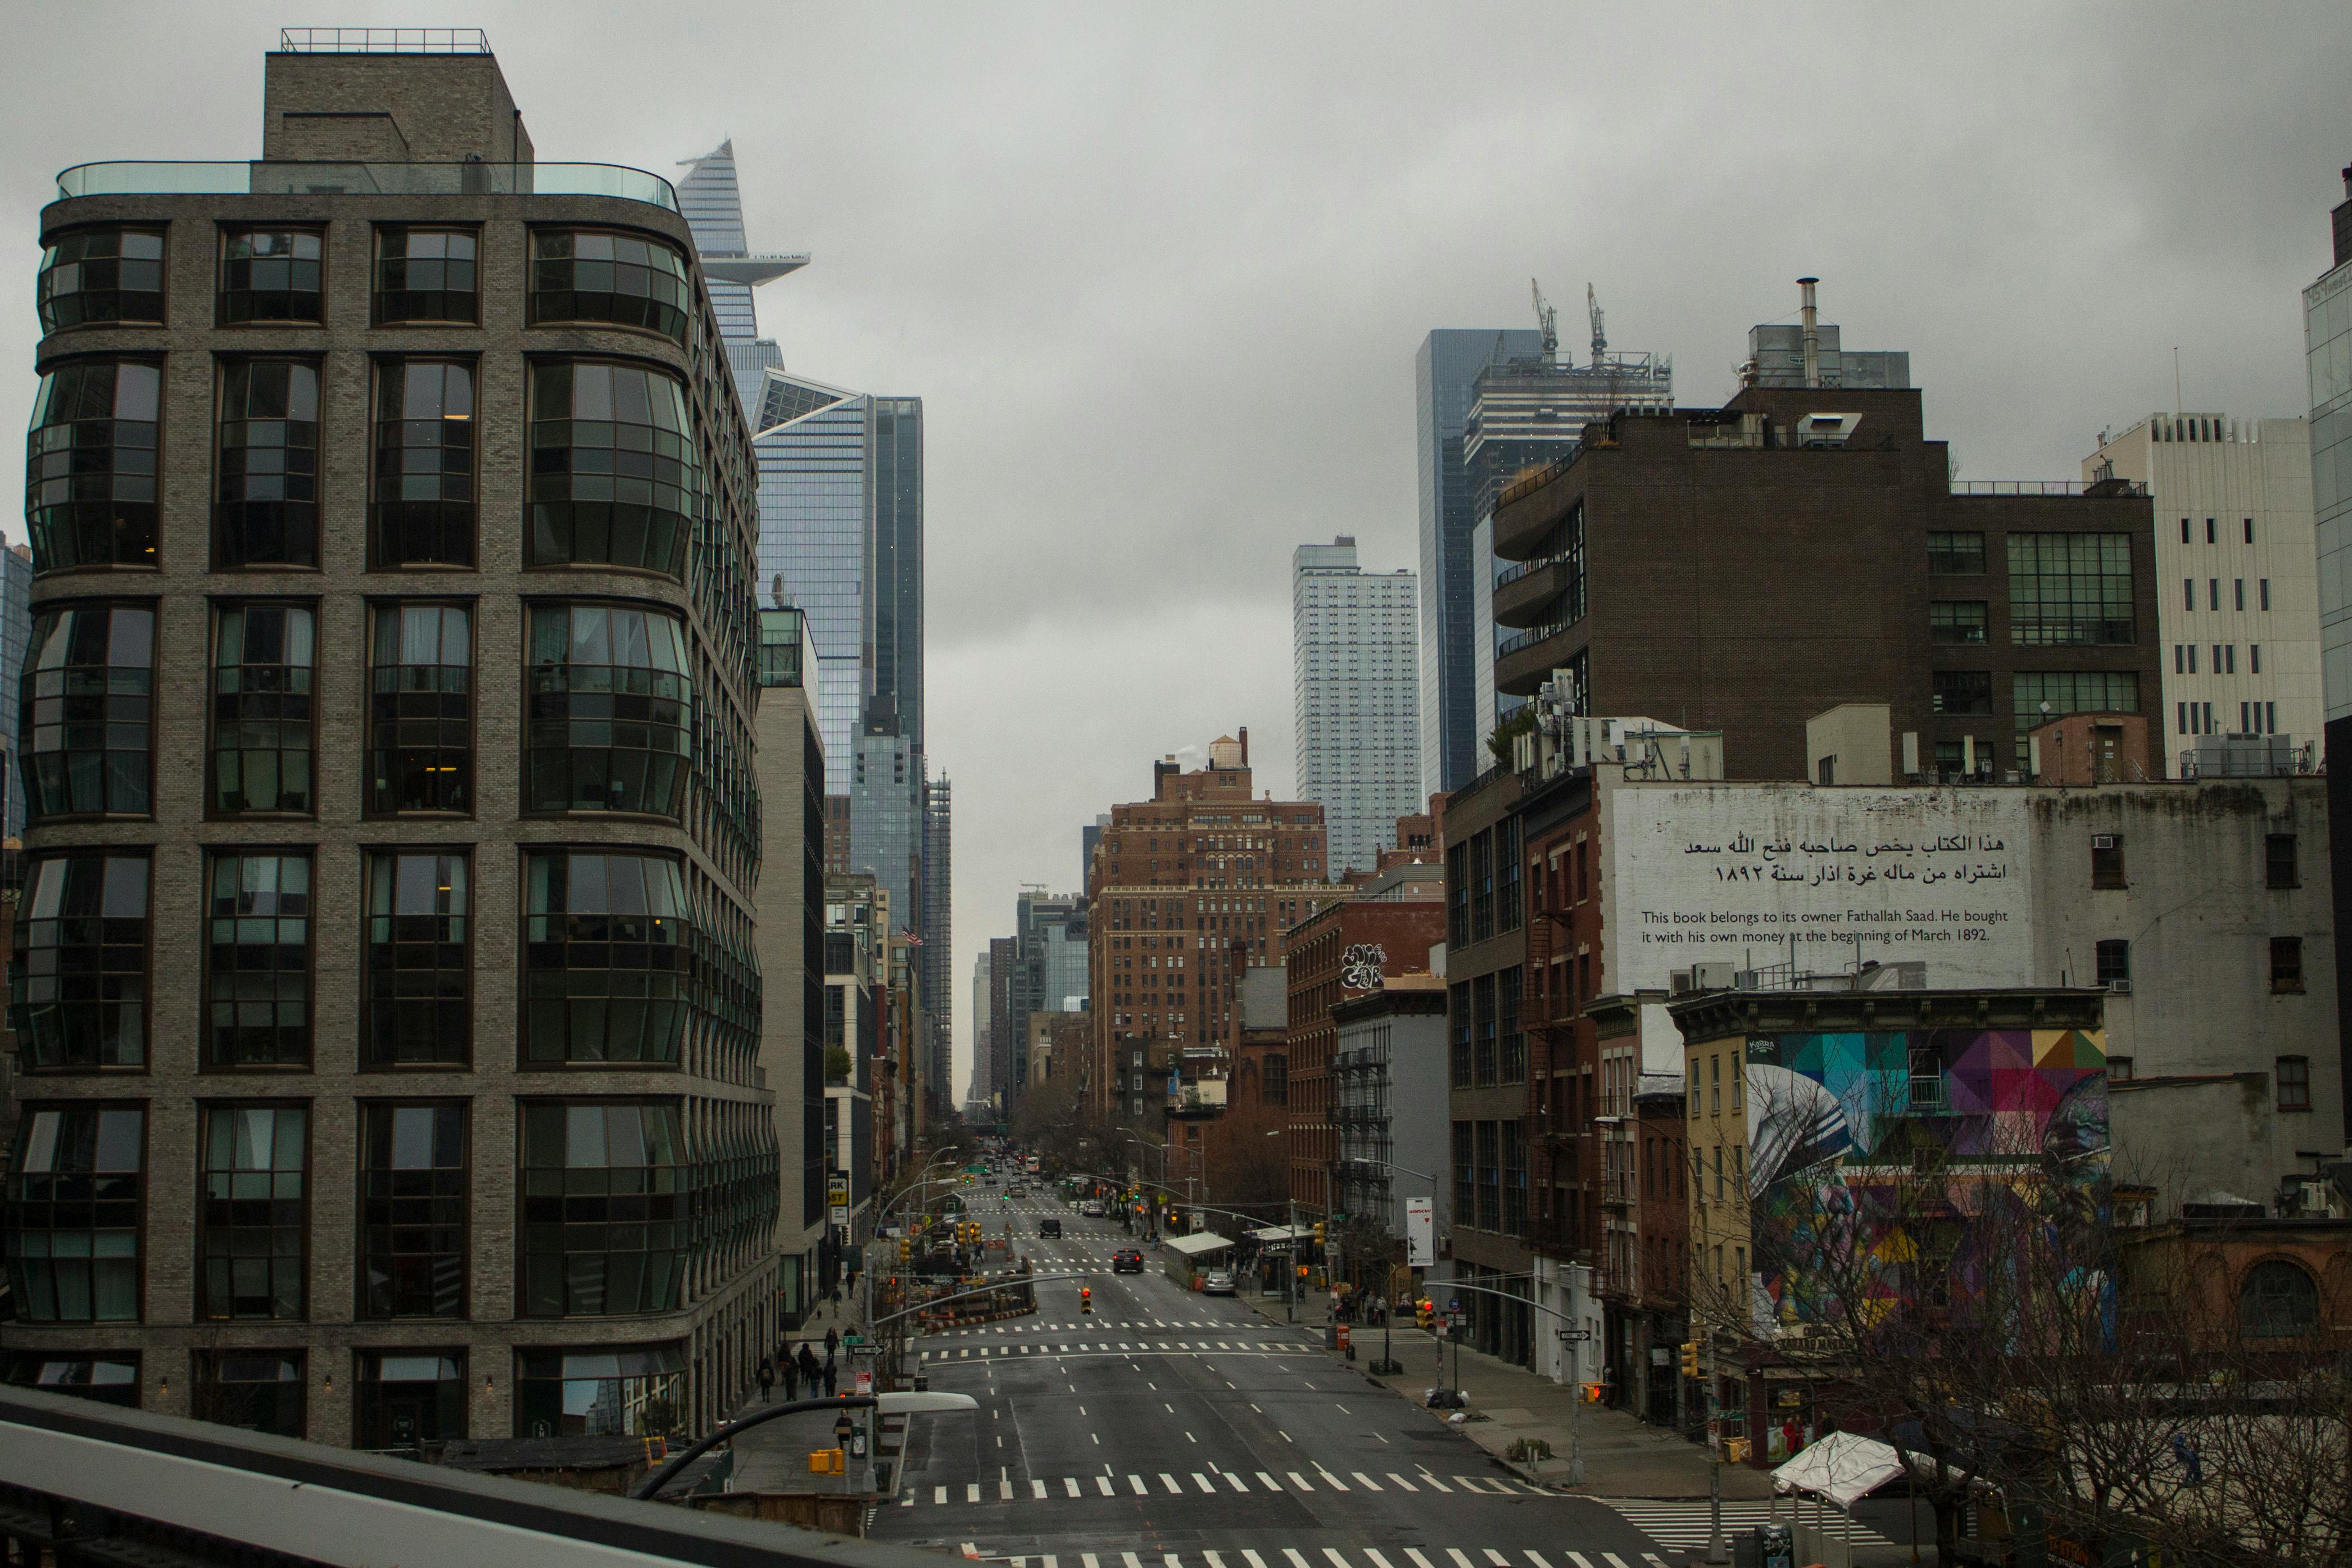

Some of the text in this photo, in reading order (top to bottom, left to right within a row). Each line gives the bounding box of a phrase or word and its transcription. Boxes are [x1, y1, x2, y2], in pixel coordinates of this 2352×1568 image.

[1684, 842, 1721, 854] سعد
[1762, 837, 1791, 861] فتح
[1799, 836, 1857, 858] صاحبه
[1865, 837, 1913, 857] يخص
[1921, 833, 1972, 858] الكتاب
[1979, 834, 2004, 851] هذا
[1716, 863, 2006, 886] اشتراه من ماله غرة اذار سنة ١٨٩٢
[1642, 909, 2009, 926] This book belongs to its owner Fathallah Saad. He bought
[1642, 931, 1651, 943] it
[1655, 931, 1683, 943] with
[1688, 931, 1706, 943] his
[1710, 933, 1737, 942] own
[1742, 932, 1785, 945] money
[1806, 930, 1827, 942] the
[1831, 930, 1891, 945] beginning
[1895, 929, 1908, 941] of
[1912, 929, 1950, 941] March
[1957, 929, 1990, 941] 1892.
[1749, 1040, 1775, 1049] KOBRA
